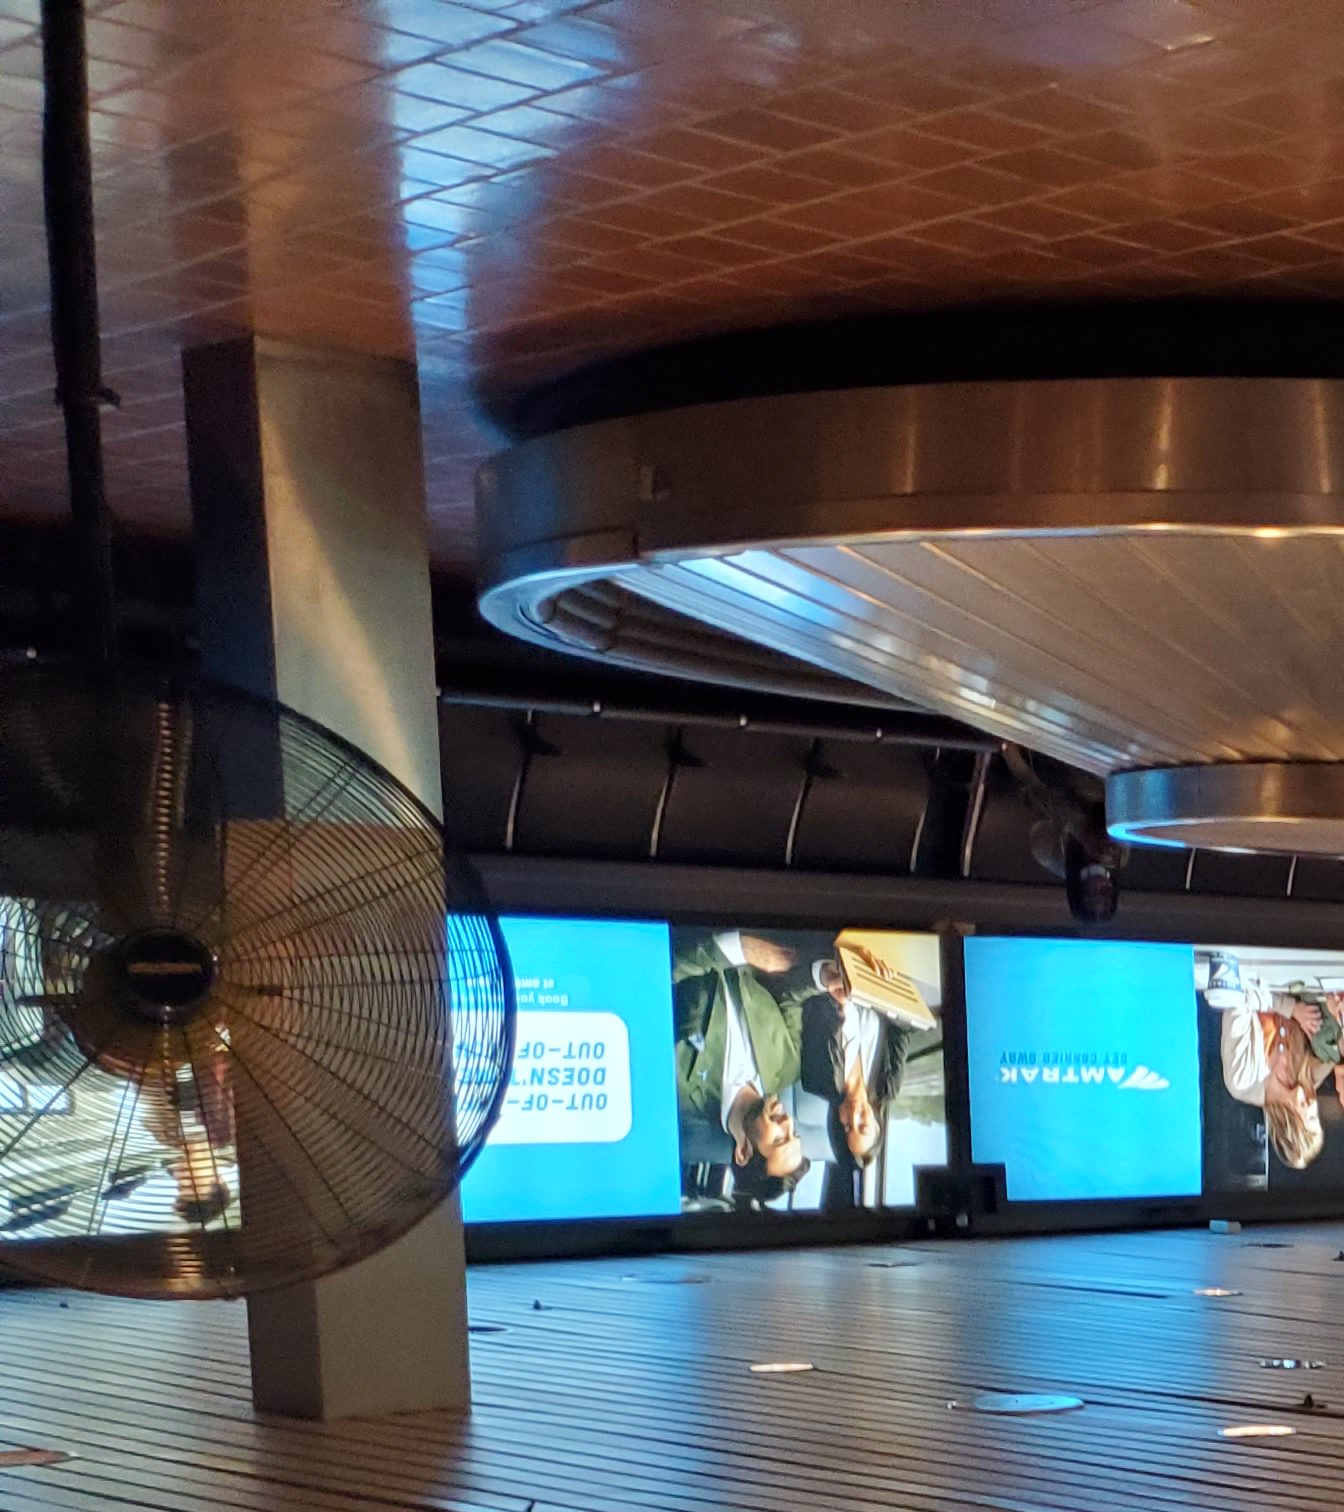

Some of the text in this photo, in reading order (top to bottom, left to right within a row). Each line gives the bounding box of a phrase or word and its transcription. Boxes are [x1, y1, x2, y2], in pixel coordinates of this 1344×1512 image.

[538, 994, 568, 1006] Book
[999, 1050, 1128, 1065] GET CARRIED AWAY
[999, 1066, 1126, 1083] AMTRAK
